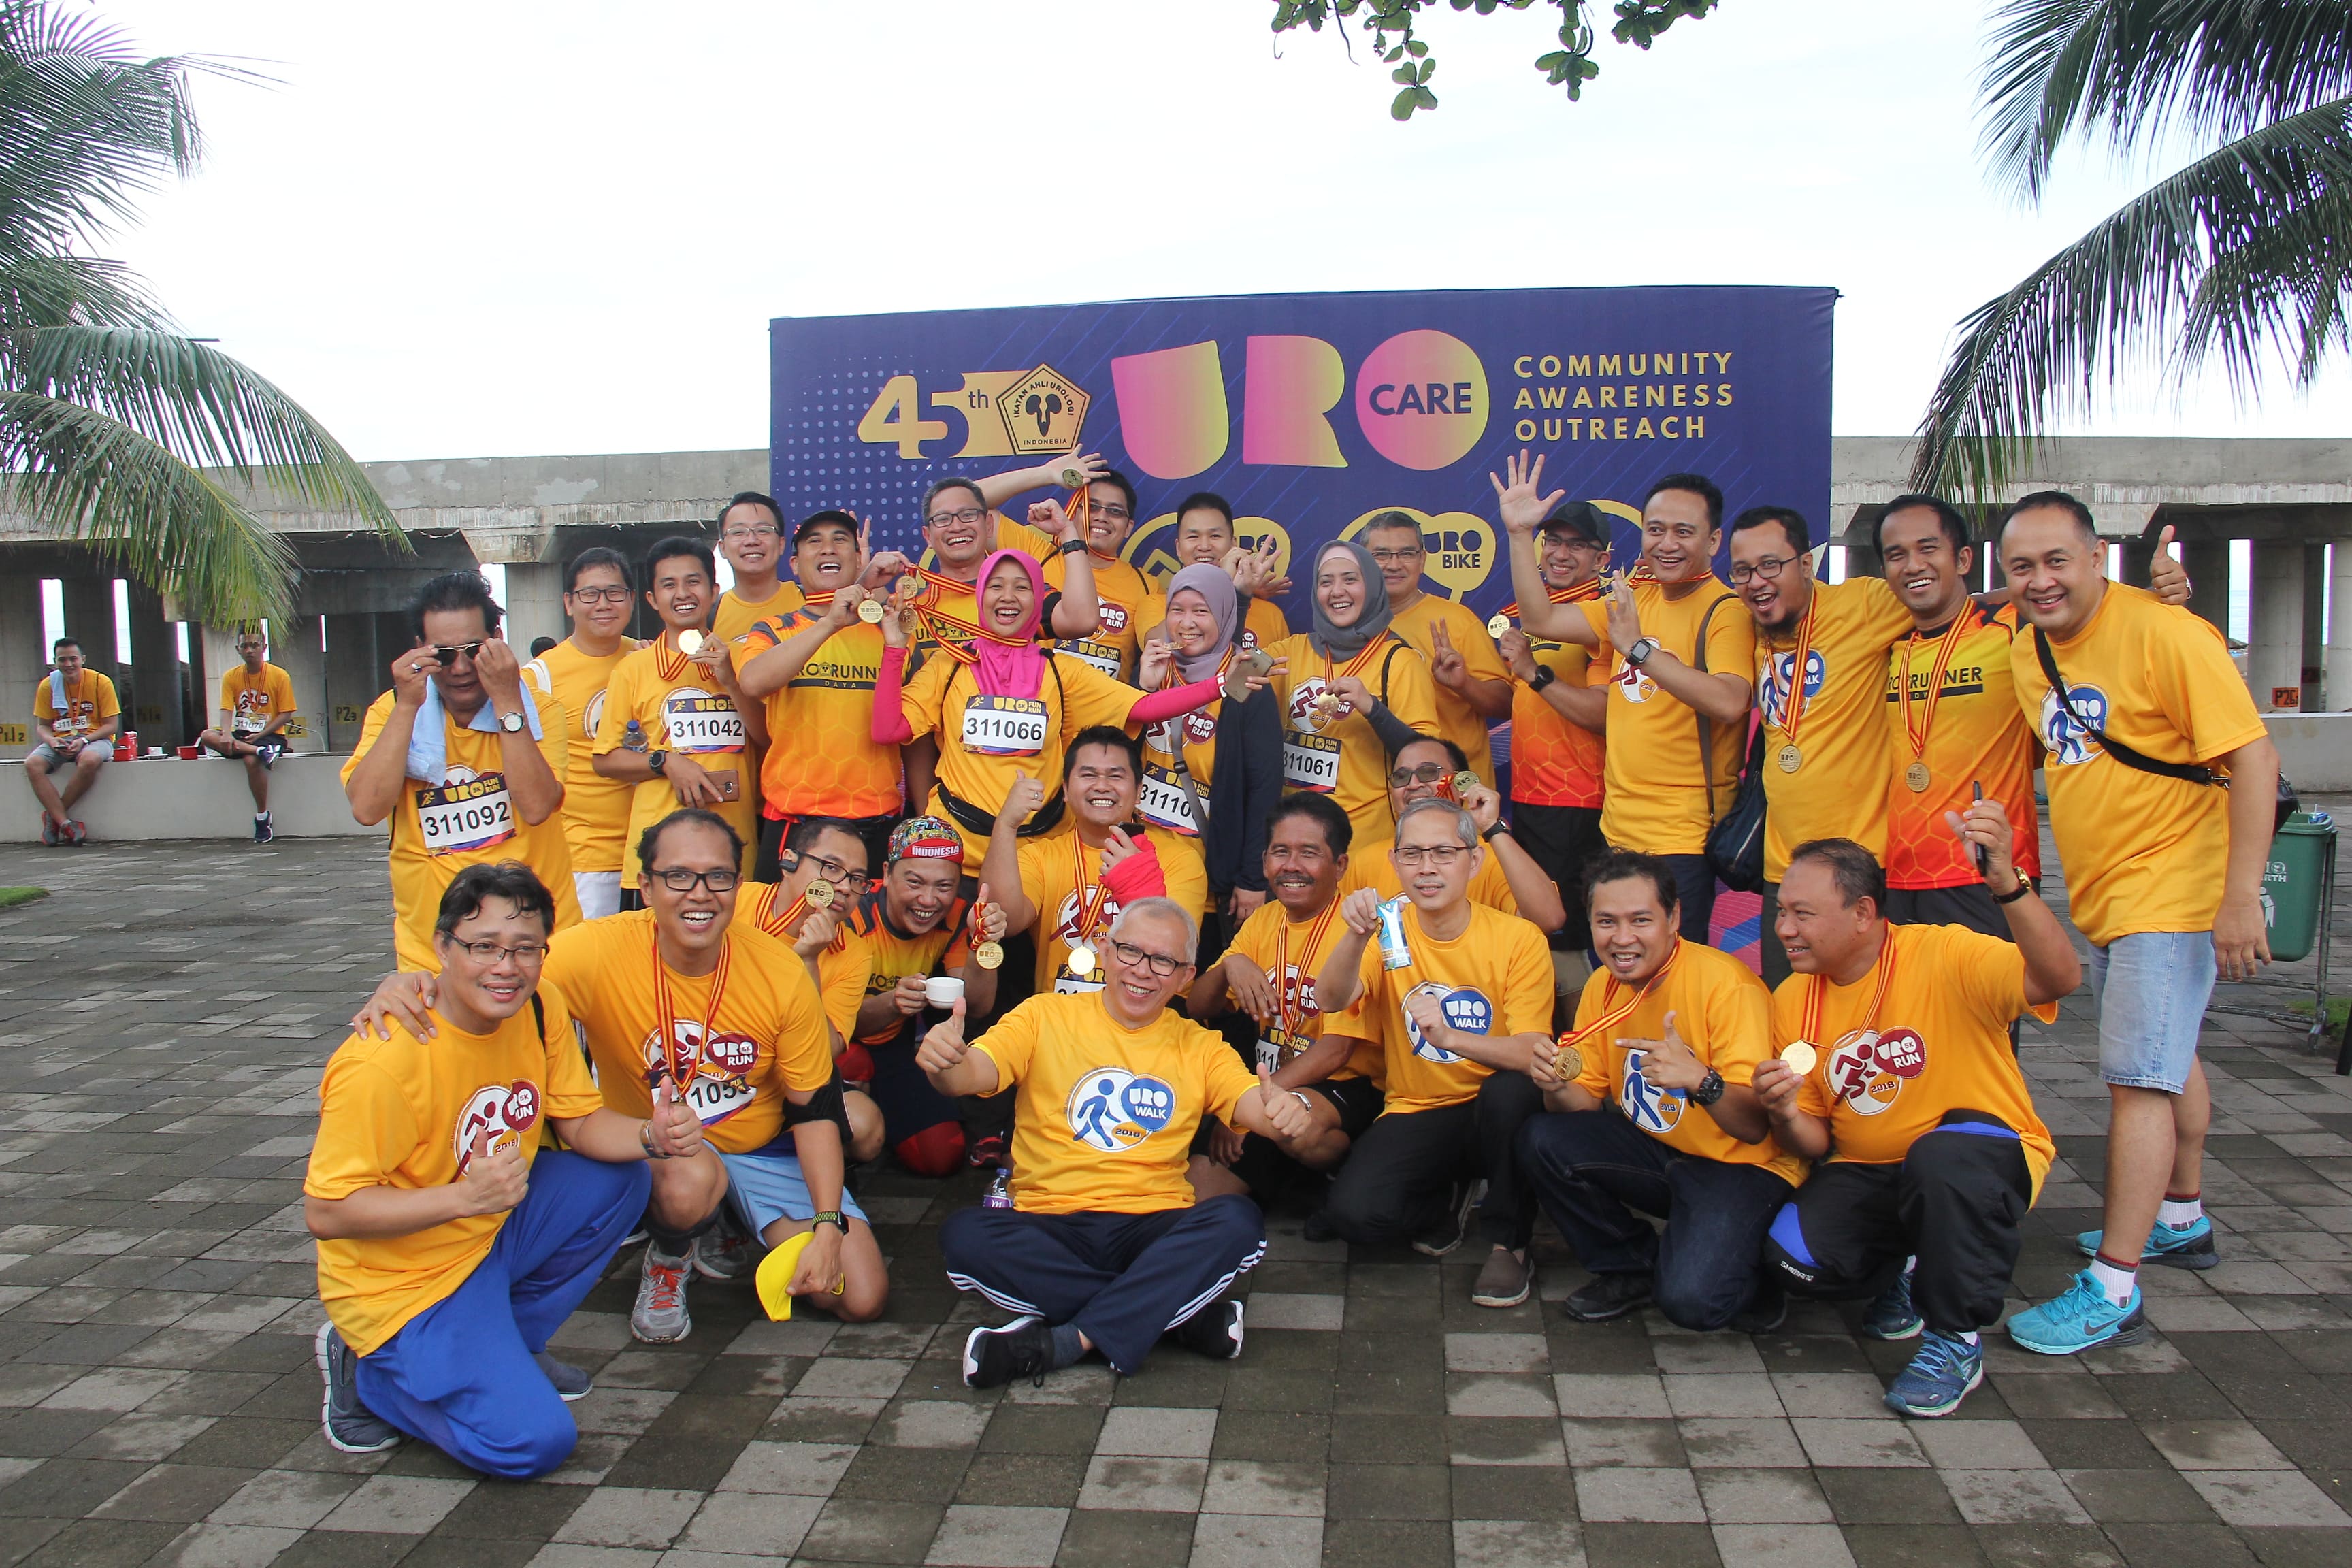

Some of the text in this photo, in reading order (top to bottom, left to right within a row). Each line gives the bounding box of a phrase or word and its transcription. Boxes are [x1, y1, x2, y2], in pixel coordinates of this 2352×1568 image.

[1514, 352, 1733, 378] COMMUNITY
[1014, 381, 1074, 418] IKATAN AHLI UROLOGI
[1369, 382, 1472, 416] CARE
[1513, 383, 1733, 410] AWARENESS
[1111, 329, 1490, 480] URO
[1514, 416, 1704, 442] OUTREACH
[1239, 534, 1277, 556] RO
[1423, 530, 1482, 553] URO
[1443, 554, 1480, 569] BIKE
[1100, 608, 1124, 621] URO
[1106, 619, 1123, 628] RUN
[1079, 642, 1107, 657] URO
[831, 664, 881, 679] RUNN
[1910, 666, 1982, 689] RUNER
[1804, 674, 1820, 685] ALK
[695, 699, 727, 711] URO
[994, 697, 1028, 712] URO
[1338, 704, 1350, 713] UN
[674, 719, 742, 737] 311042
[966, 717, 1043, 741] 311066
[1188, 715, 1214, 730] URO
[1191, 726, 1211, 738] RUN
[1298, 734, 1325, 749] URO
[1284, 751, 1334, 777] 311061
[483, 777, 499, 787] FUN
[485, 784, 501, 794] RUN
[1197, 784, 1209, 792] FUN
[444, 782, 485, 802] URO
[1196, 789, 1209, 798] RUN
[1140, 784, 1192, 817] 31110
[425, 801, 510, 836] 311092
[912, 845, 959, 857] INDONESIA
[1084, 970, 1106, 983] UR
[1446, 1000, 1486, 1017] URO
[1454, 1018, 1487, 1028] WALK
[713, 1041, 753, 1057] URO
[1296, 1037, 1310, 1046] FUN
[1876, 1036, 1916, 1060] URO
[728, 1055, 753, 1066] RUN
[1893, 1052, 1921, 1068] RUN
[1870, 1081, 1895, 1093] 2018
[1129, 1088, 1168, 1107] URO
[515, 1105, 534, 1121] UN
[1135, 1106, 1167, 1120] WALK
[1115, 1128, 1141, 1137] 2018
